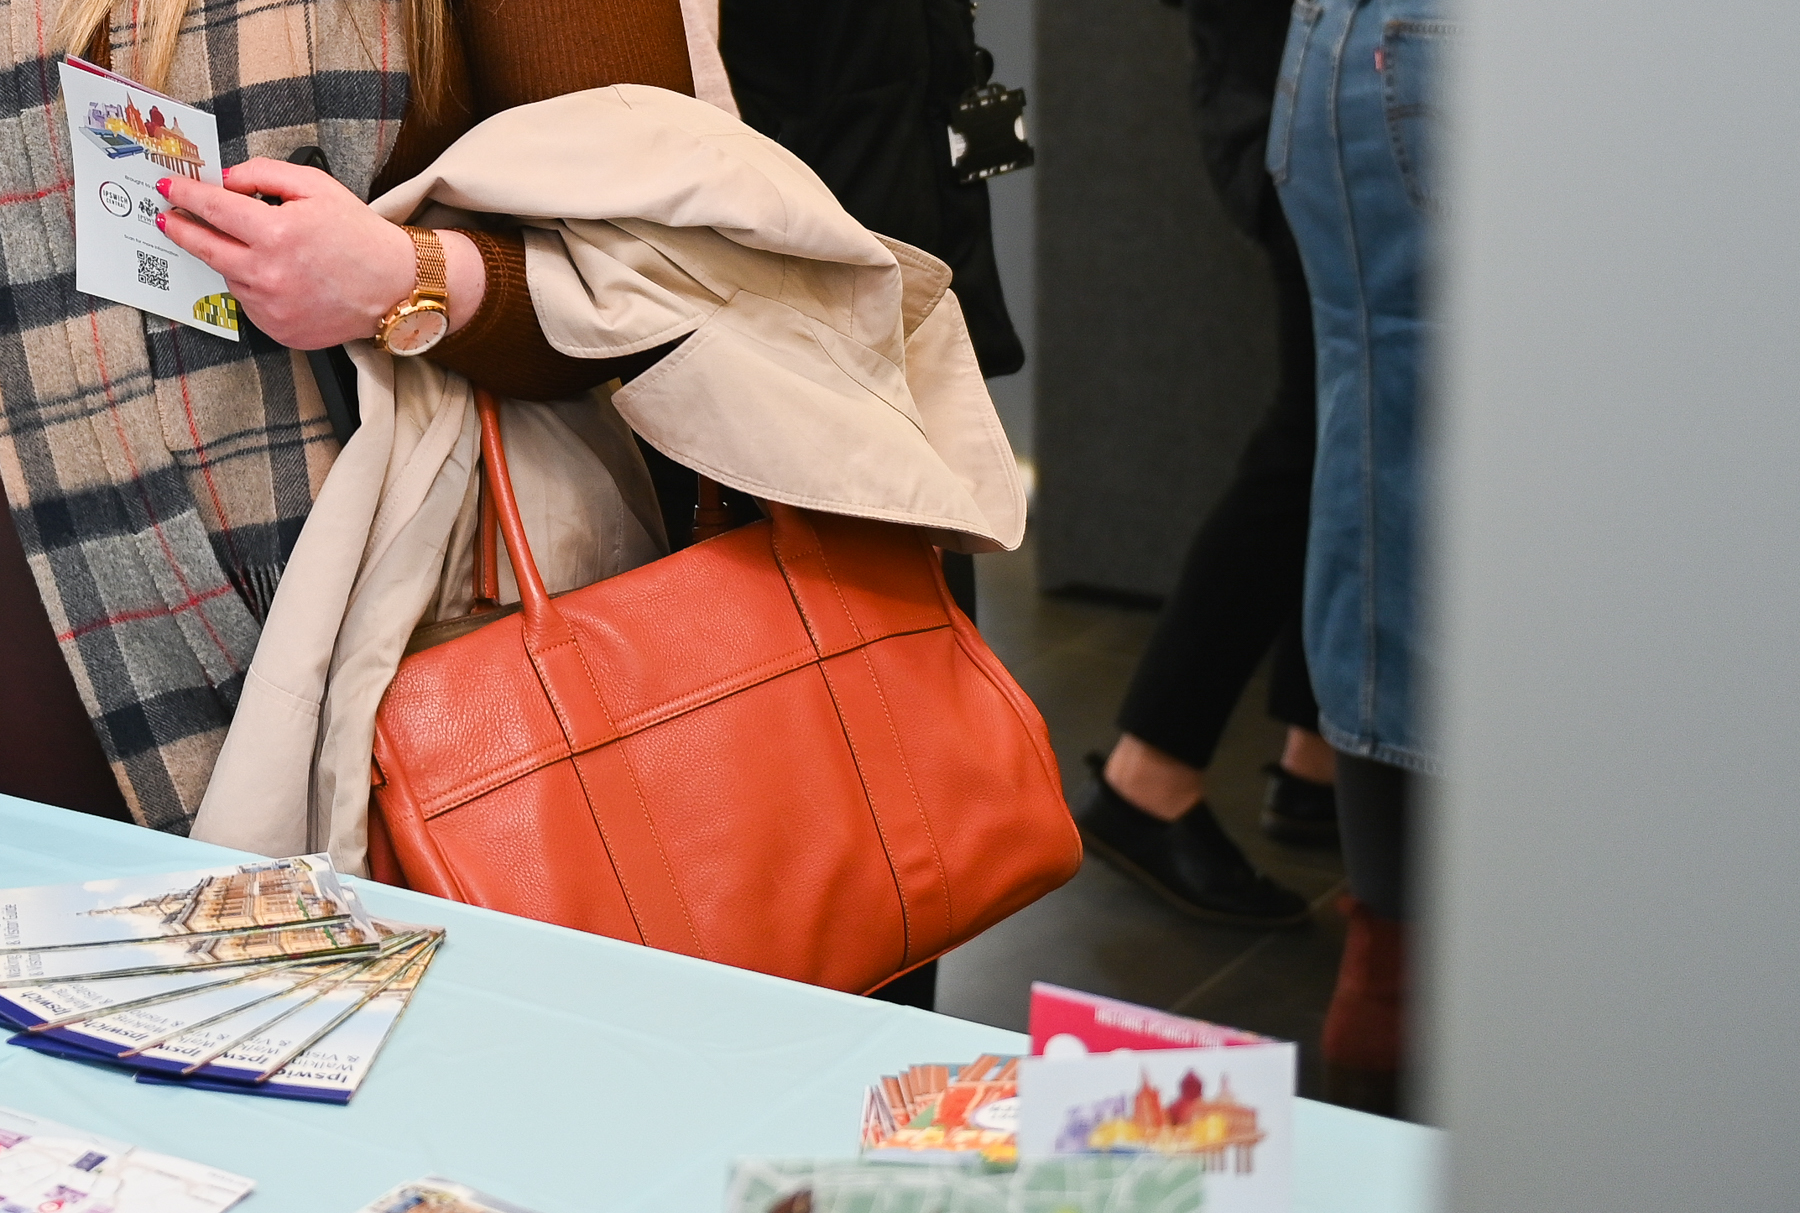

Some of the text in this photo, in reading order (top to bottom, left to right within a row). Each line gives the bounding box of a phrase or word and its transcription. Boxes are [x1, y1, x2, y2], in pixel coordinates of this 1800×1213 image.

[102, 189, 129, 205] IPSWICH
[105, 199, 127, 210] CENTRAL
[2, 903, 21, 946] & Visitor Guide
[19, 990, 72, 1017] Ipswich
[273, 1067, 349, 1084] Ipswic
